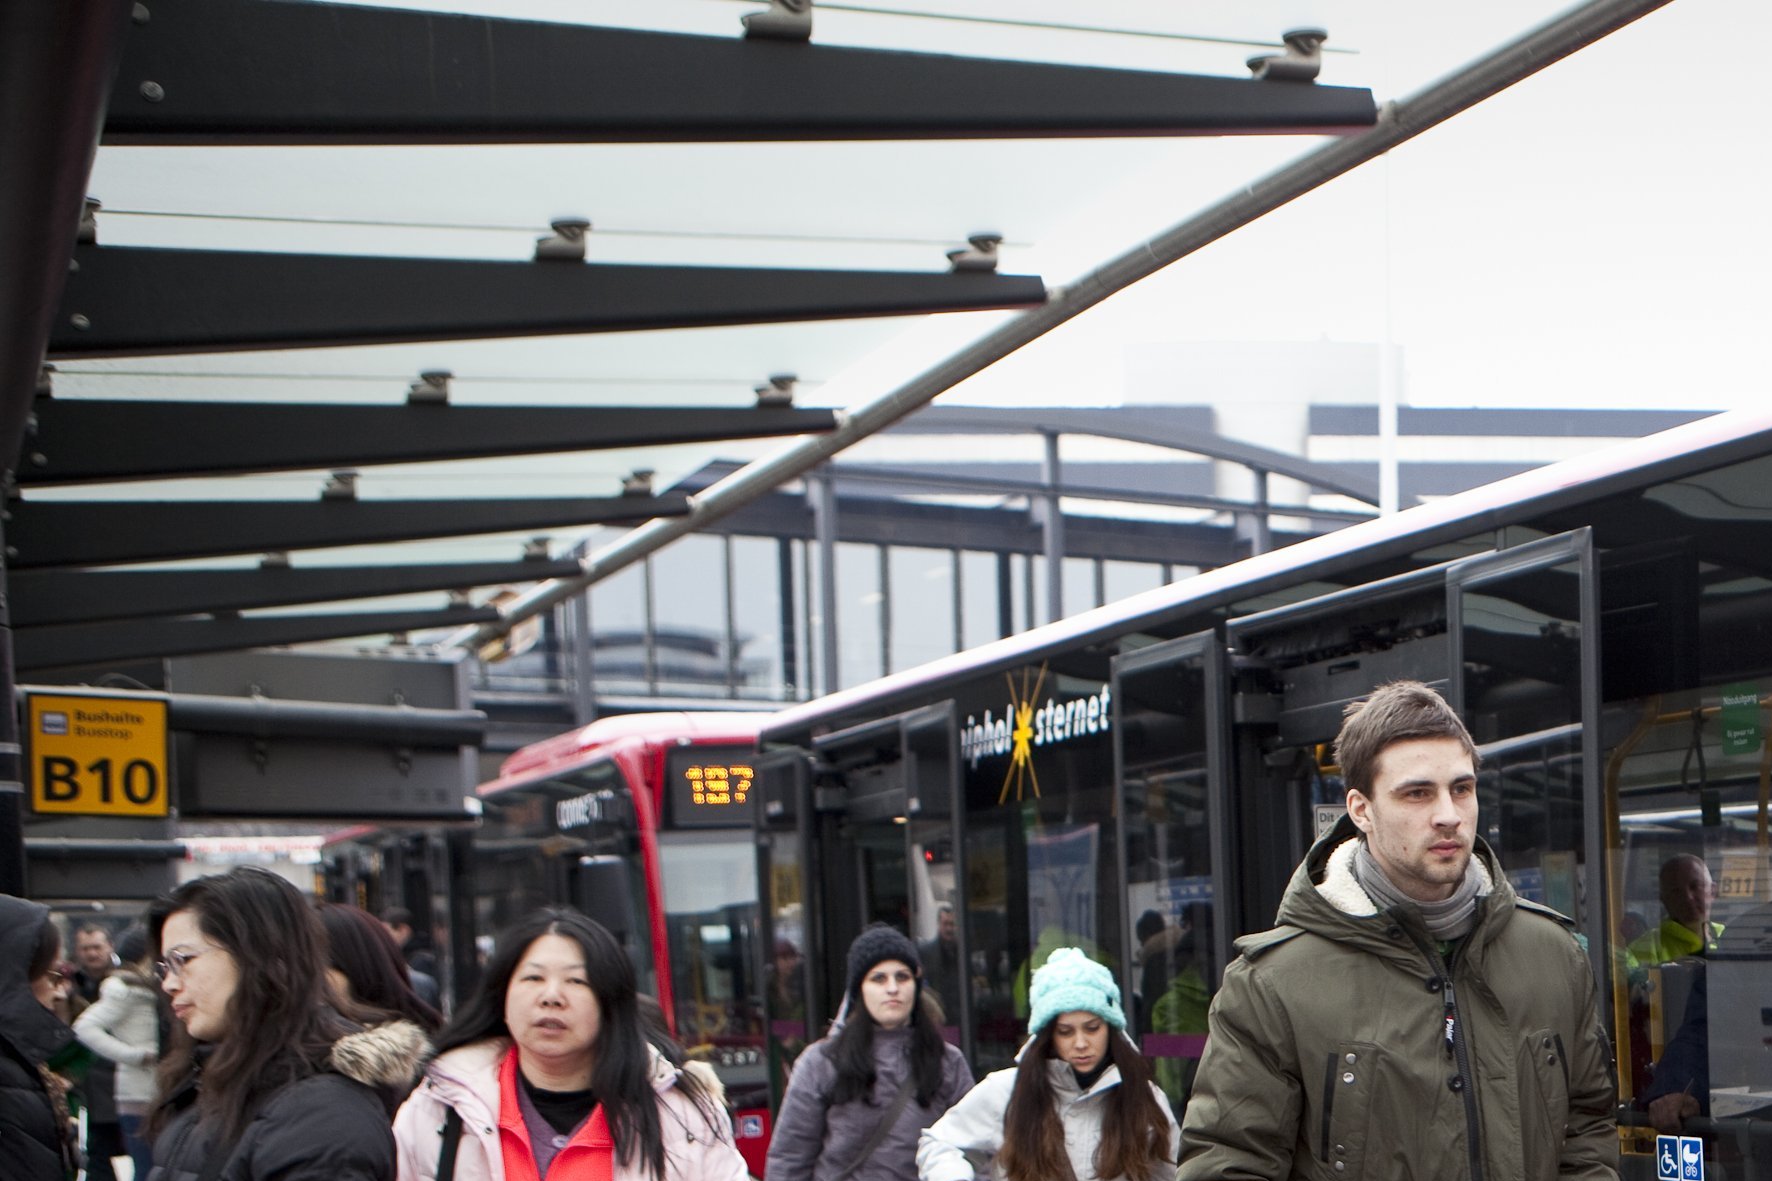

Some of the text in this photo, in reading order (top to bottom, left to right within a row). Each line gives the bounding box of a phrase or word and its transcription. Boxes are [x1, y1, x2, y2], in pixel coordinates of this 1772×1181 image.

[76, 711, 143, 725] Bushalte
[1034, 683, 1110, 747] sternet
[76, 726, 131, 740] Busstop
[43, 756, 157, 805] B10
